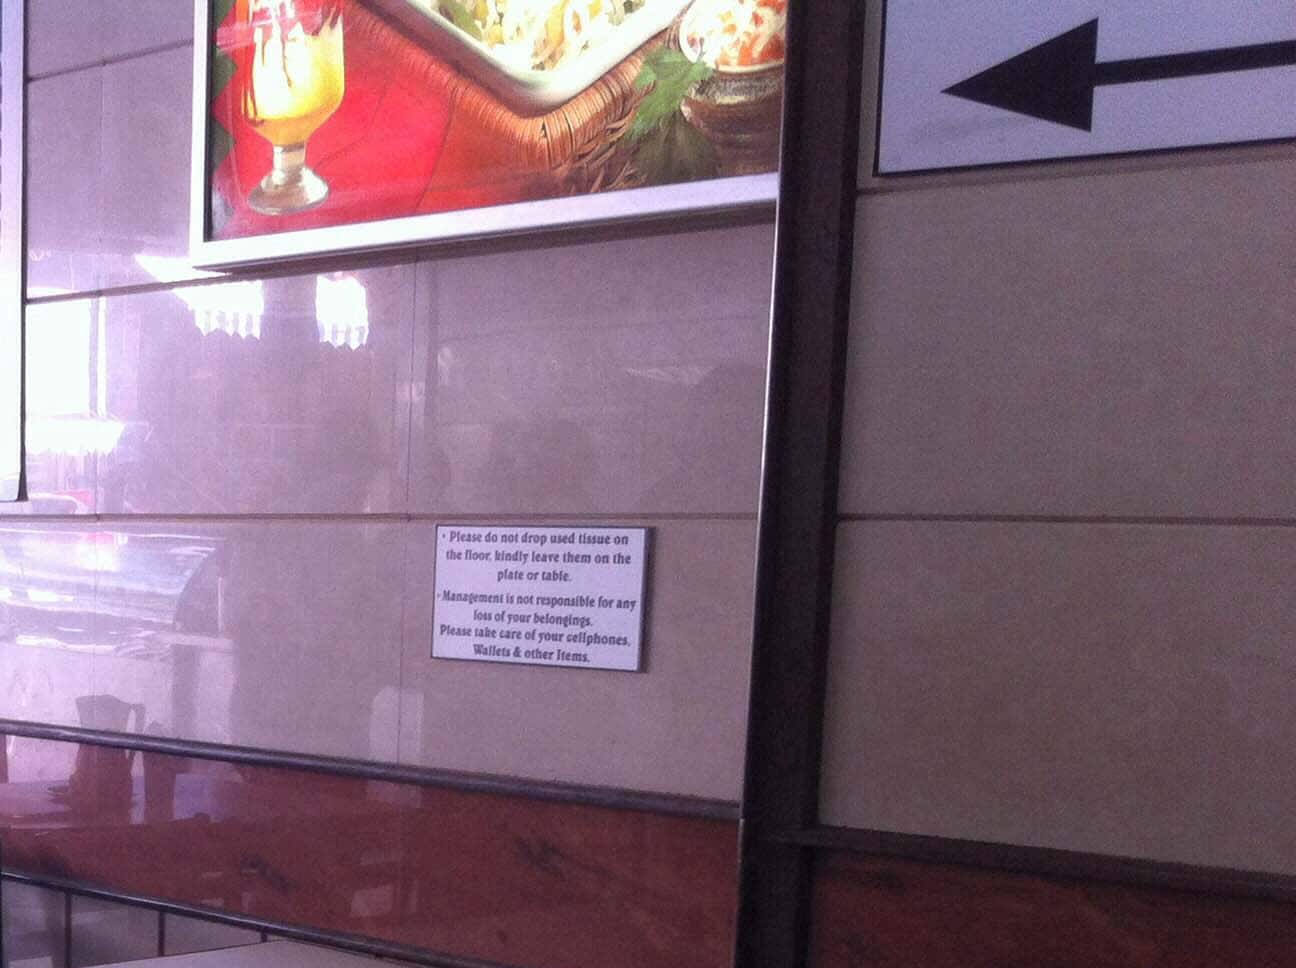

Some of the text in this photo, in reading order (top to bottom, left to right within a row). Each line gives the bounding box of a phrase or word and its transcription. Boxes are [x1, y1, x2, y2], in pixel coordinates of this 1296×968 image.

[449, 531, 629, 547] Please do not drop used tissue on
[446, 549, 462, 560] the
[495, 550, 529, 565] kindly
[531, 551, 559, 562] leave
[563, 551, 591, 563] them
[594, 554, 609, 564] on
[613, 552, 632, 564] the
[497, 568, 524, 582] plate
[526, 571, 539, 580] or
[442, 590, 637, 612] Management is not responsible for any
[473, 609, 593, 629] loss of your belongings.
[440, 624, 472, 637] Please
[474, 626, 497, 638] take
[499, 630, 522, 640] care
[524, 628, 536, 640] of
[538, 632, 564, 644] your
[473, 644, 511, 657] Wallets
[512, 646, 522, 658] &
[524, 648, 554, 660] other
